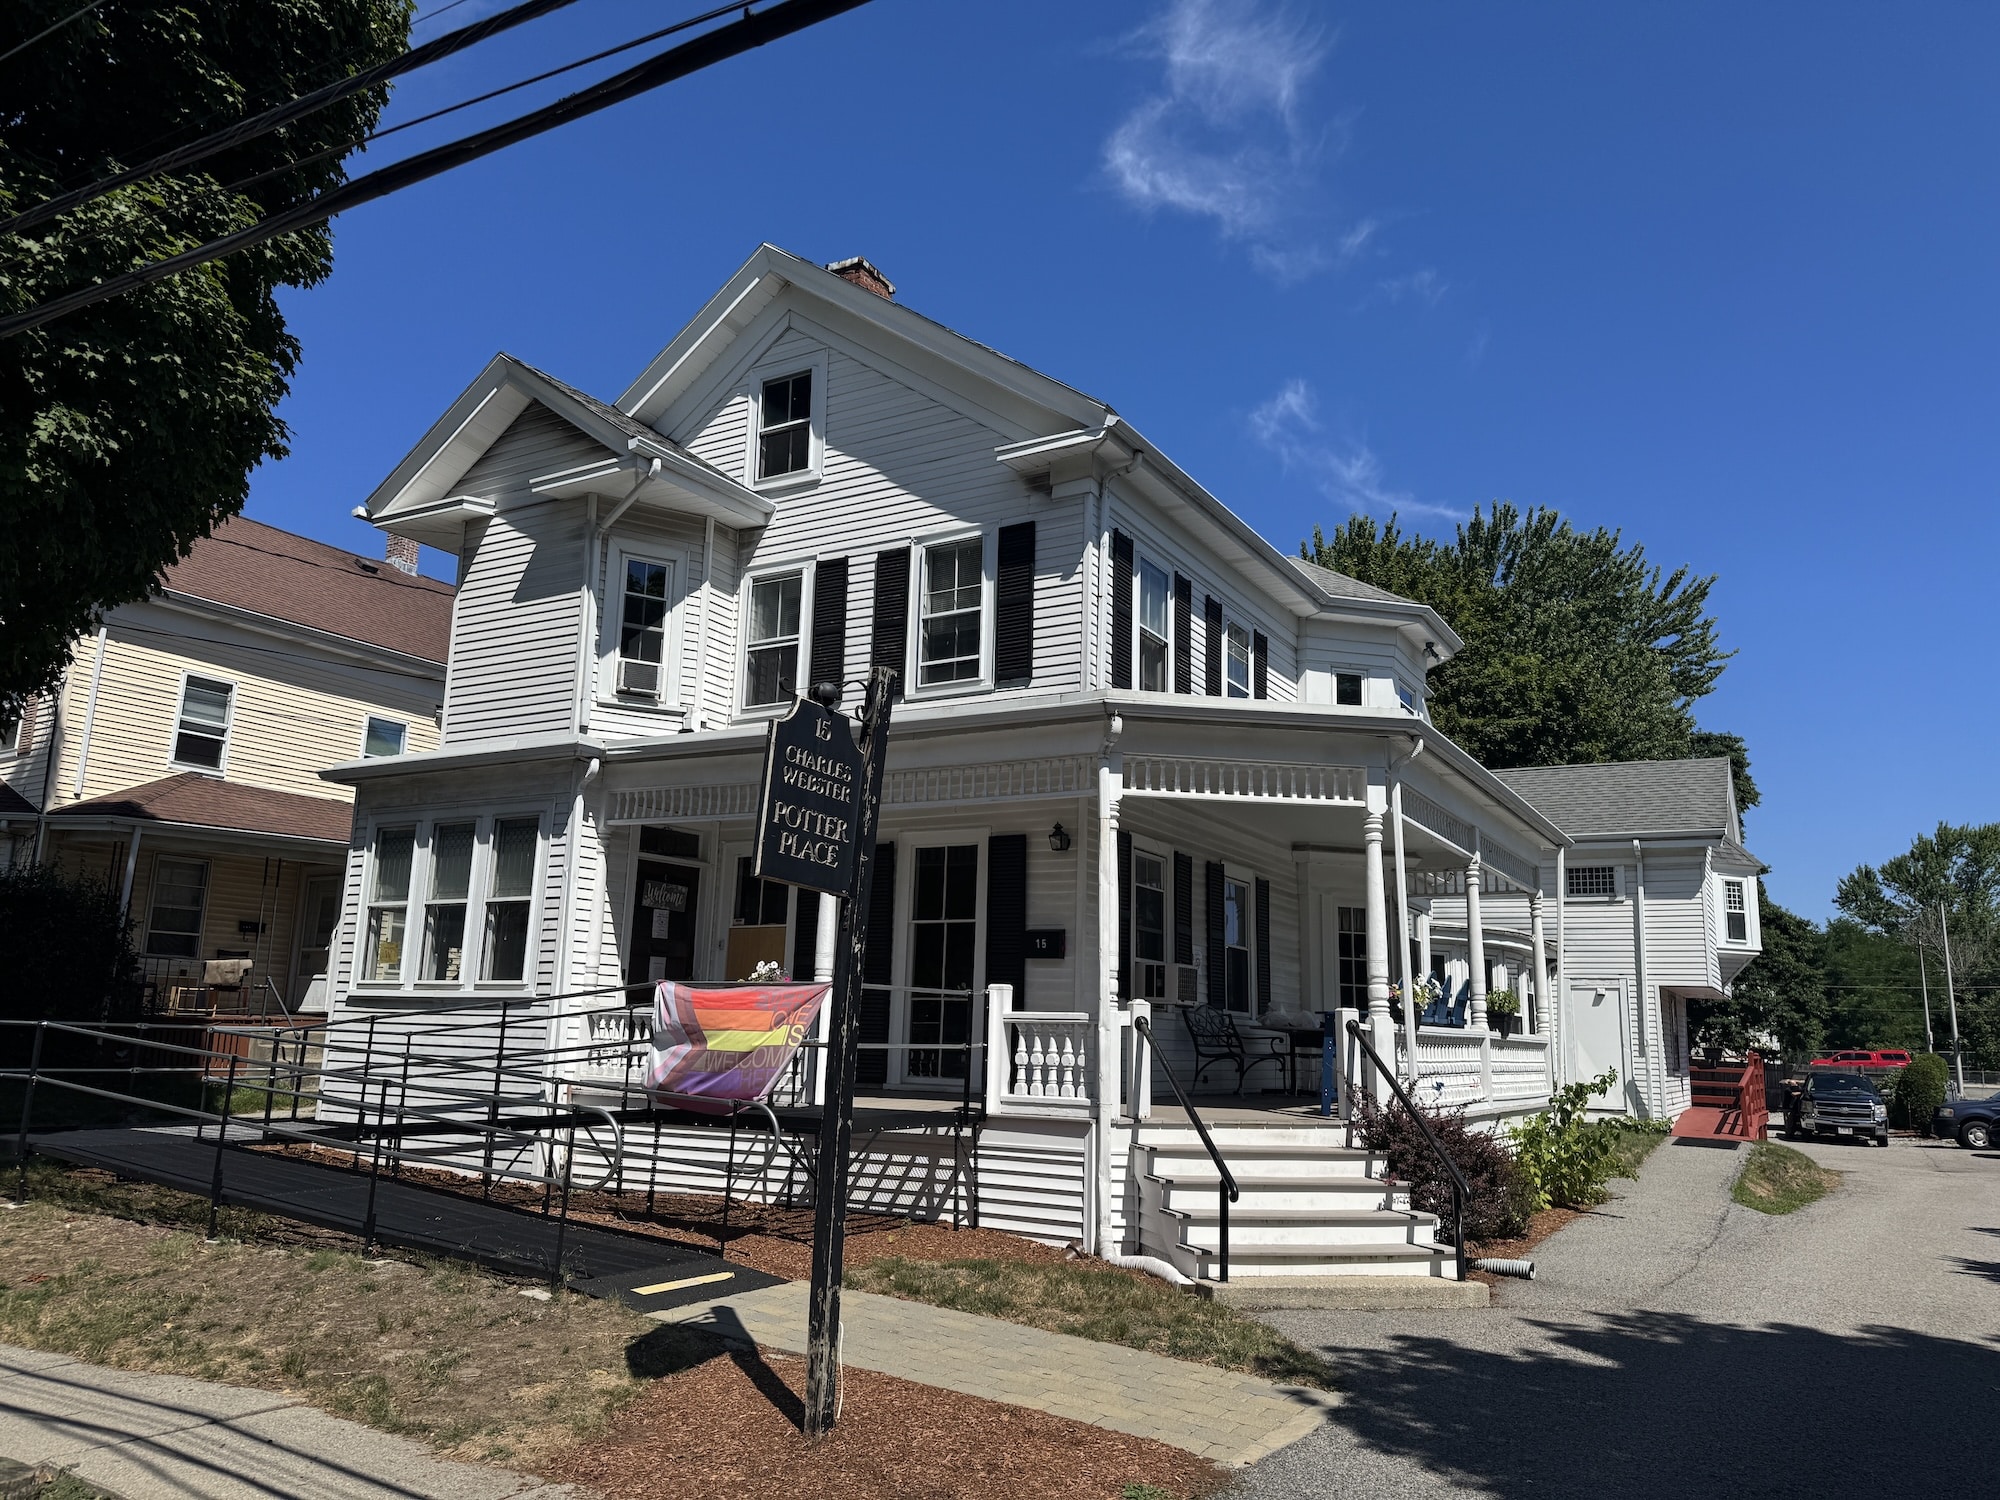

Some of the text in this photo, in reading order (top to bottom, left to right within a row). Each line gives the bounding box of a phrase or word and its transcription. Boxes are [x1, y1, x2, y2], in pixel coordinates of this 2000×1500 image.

[815, 718, 832, 741] 15
[785, 745, 852, 782] CHARLES
[783, 765, 851, 803] WEBSTER
[773, 800, 850, 843] POTTER
[779, 830, 839, 868] PLACE
[1036, 938, 1047, 948] 15
[783, 1024, 805, 1047] IS
